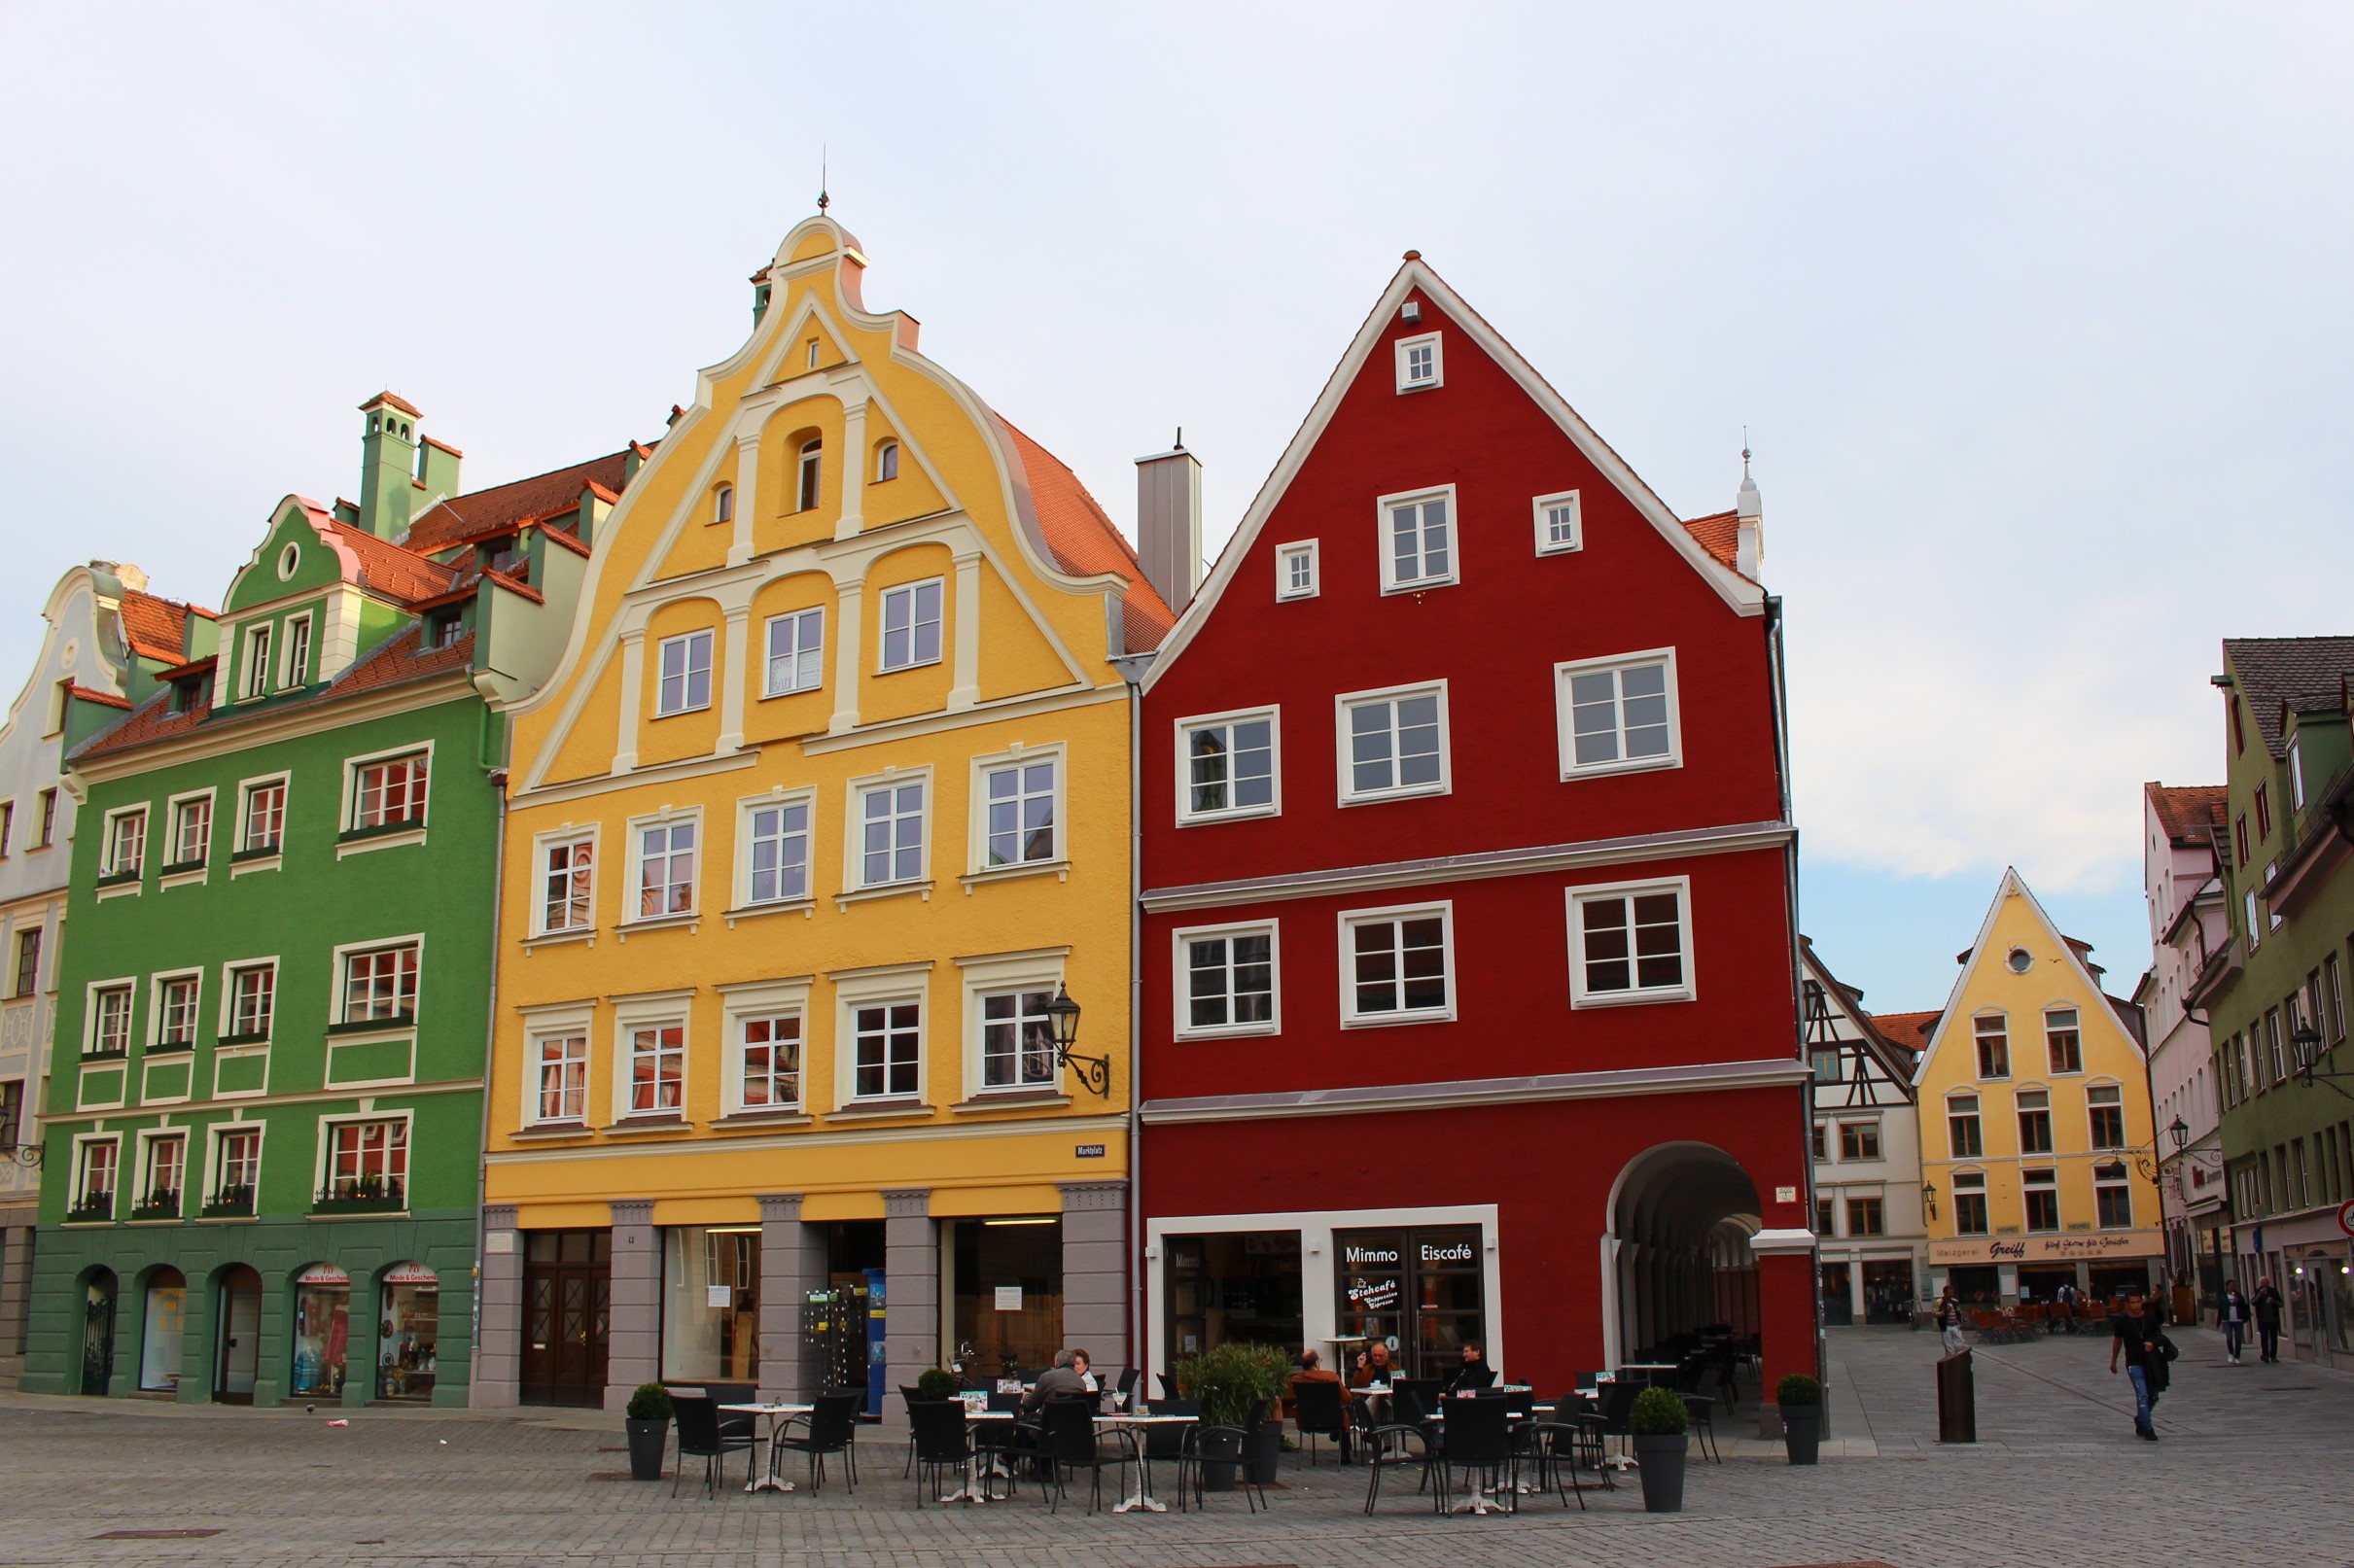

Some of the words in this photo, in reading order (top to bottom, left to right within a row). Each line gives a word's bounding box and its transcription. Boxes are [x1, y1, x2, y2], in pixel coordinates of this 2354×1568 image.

[1077, 1146, 1103, 1157] Marktplatz
[1346, 1247, 1398, 1263] Mimmo
[1421, 1243, 1472, 1260] Eiscafé
[1937, 1248, 1979, 1257] Metzgerei
[1989, 1241, 2024, 1259] Greiff
[1349, 1280, 1396, 1300] Stehcafé
[1364, 1291, 1398, 1305] Cappuccino
